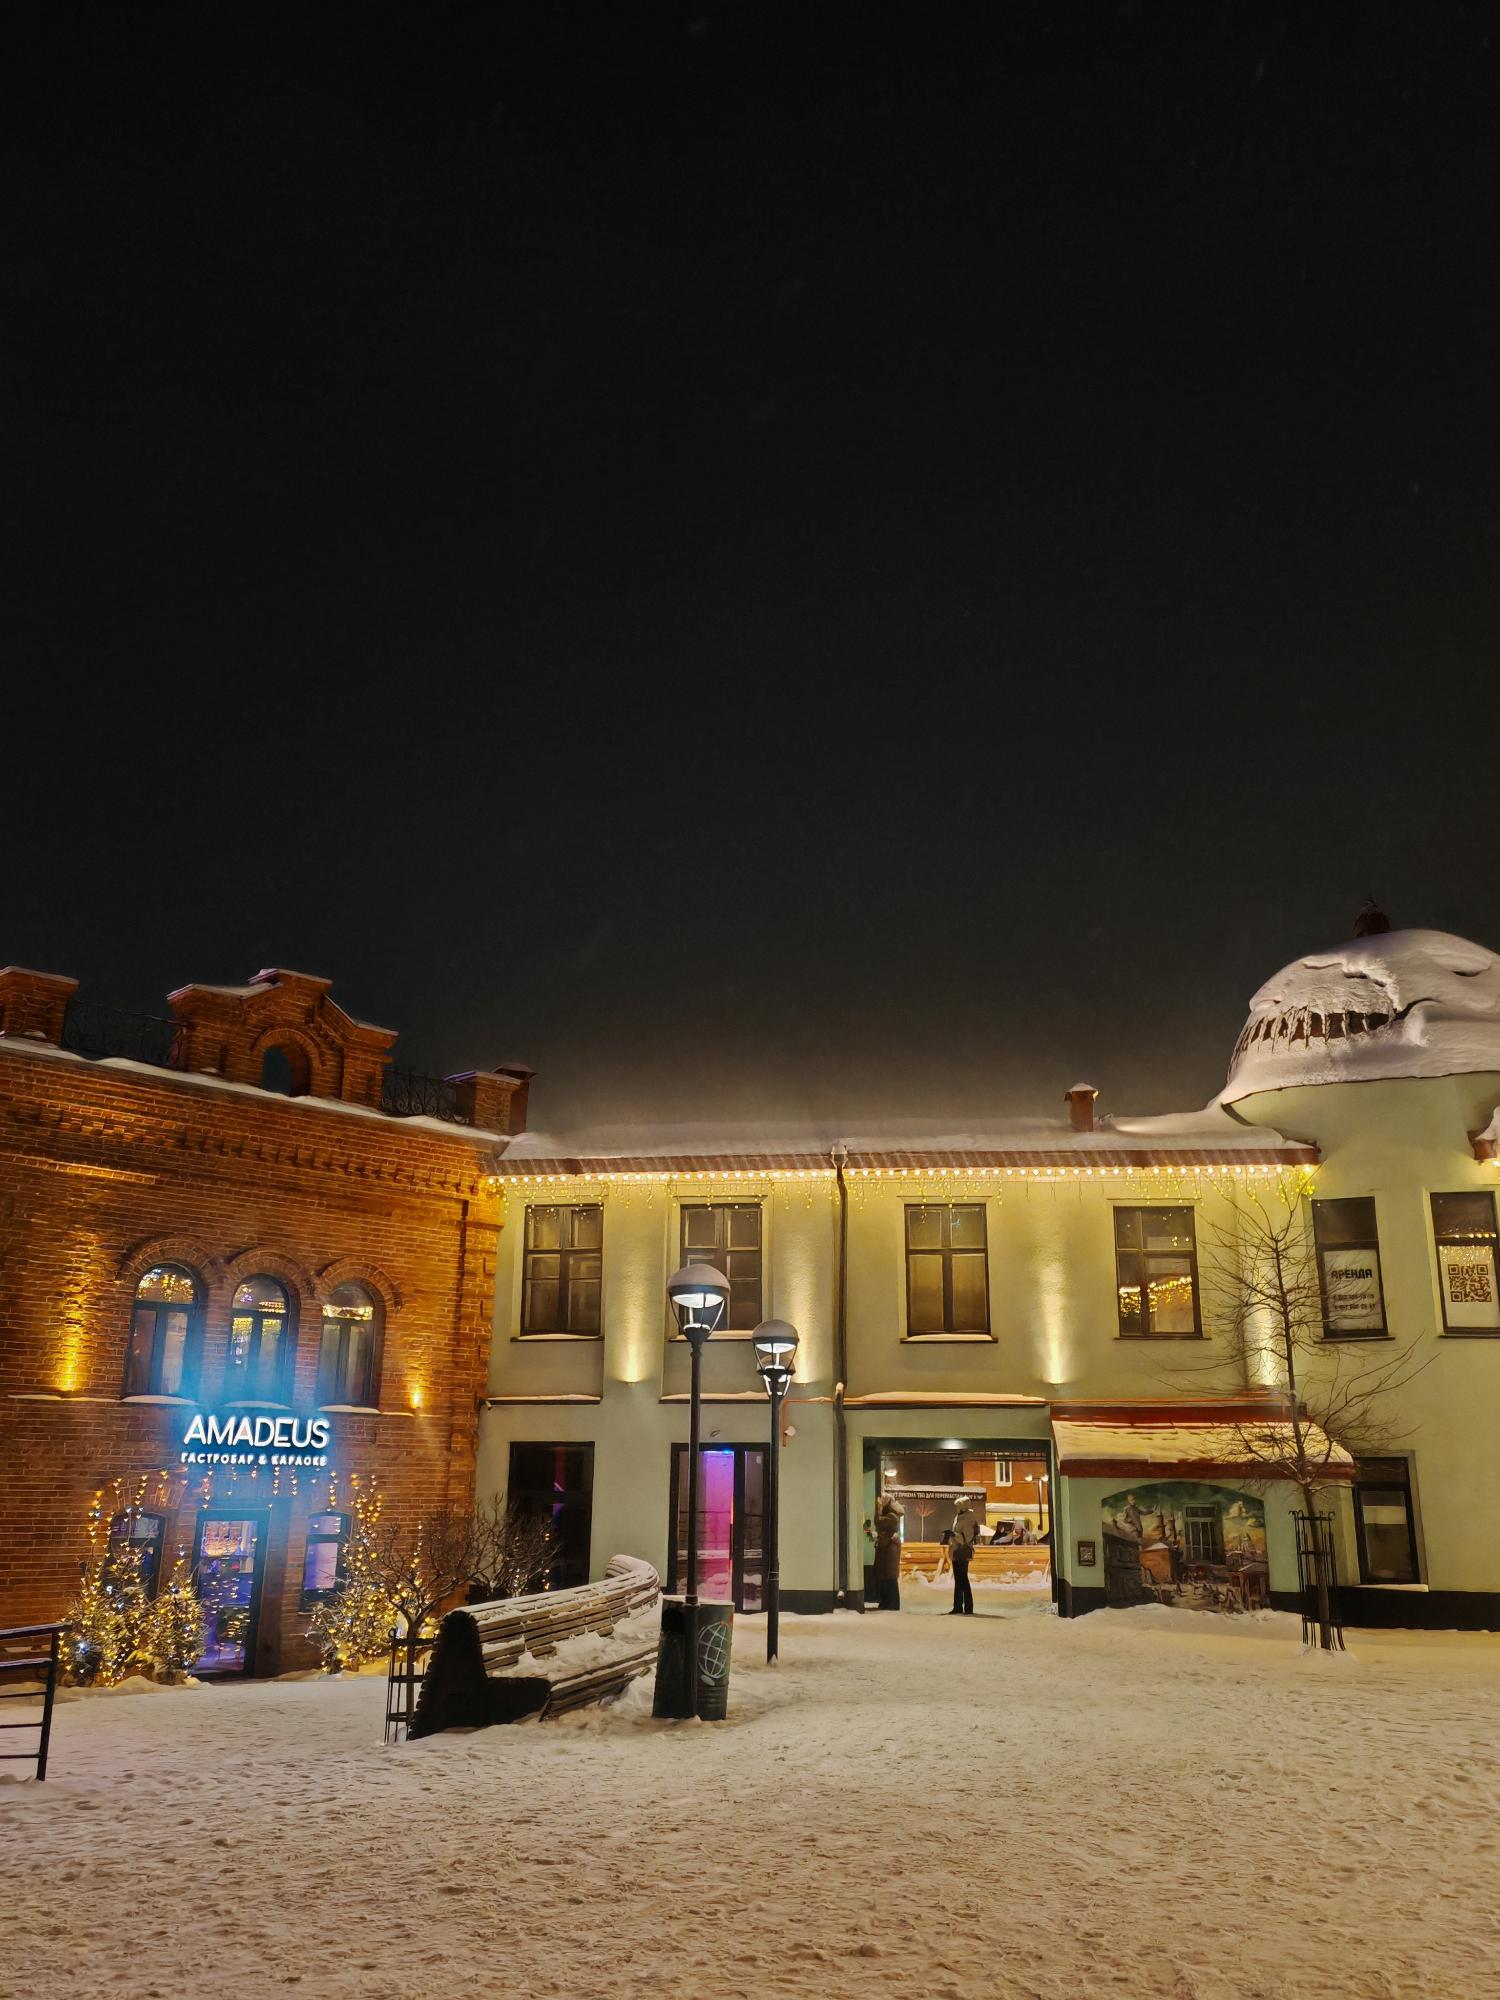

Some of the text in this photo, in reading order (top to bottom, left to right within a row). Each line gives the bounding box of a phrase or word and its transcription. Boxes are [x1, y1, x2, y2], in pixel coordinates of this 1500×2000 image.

[1330, 1268, 1373, 1279] АРЕНДА
[183, 1414, 330, 1448] AMADEUS
[181, 1452, 327, 1467] ГАСТРОБАР & КАРАОКЕ
